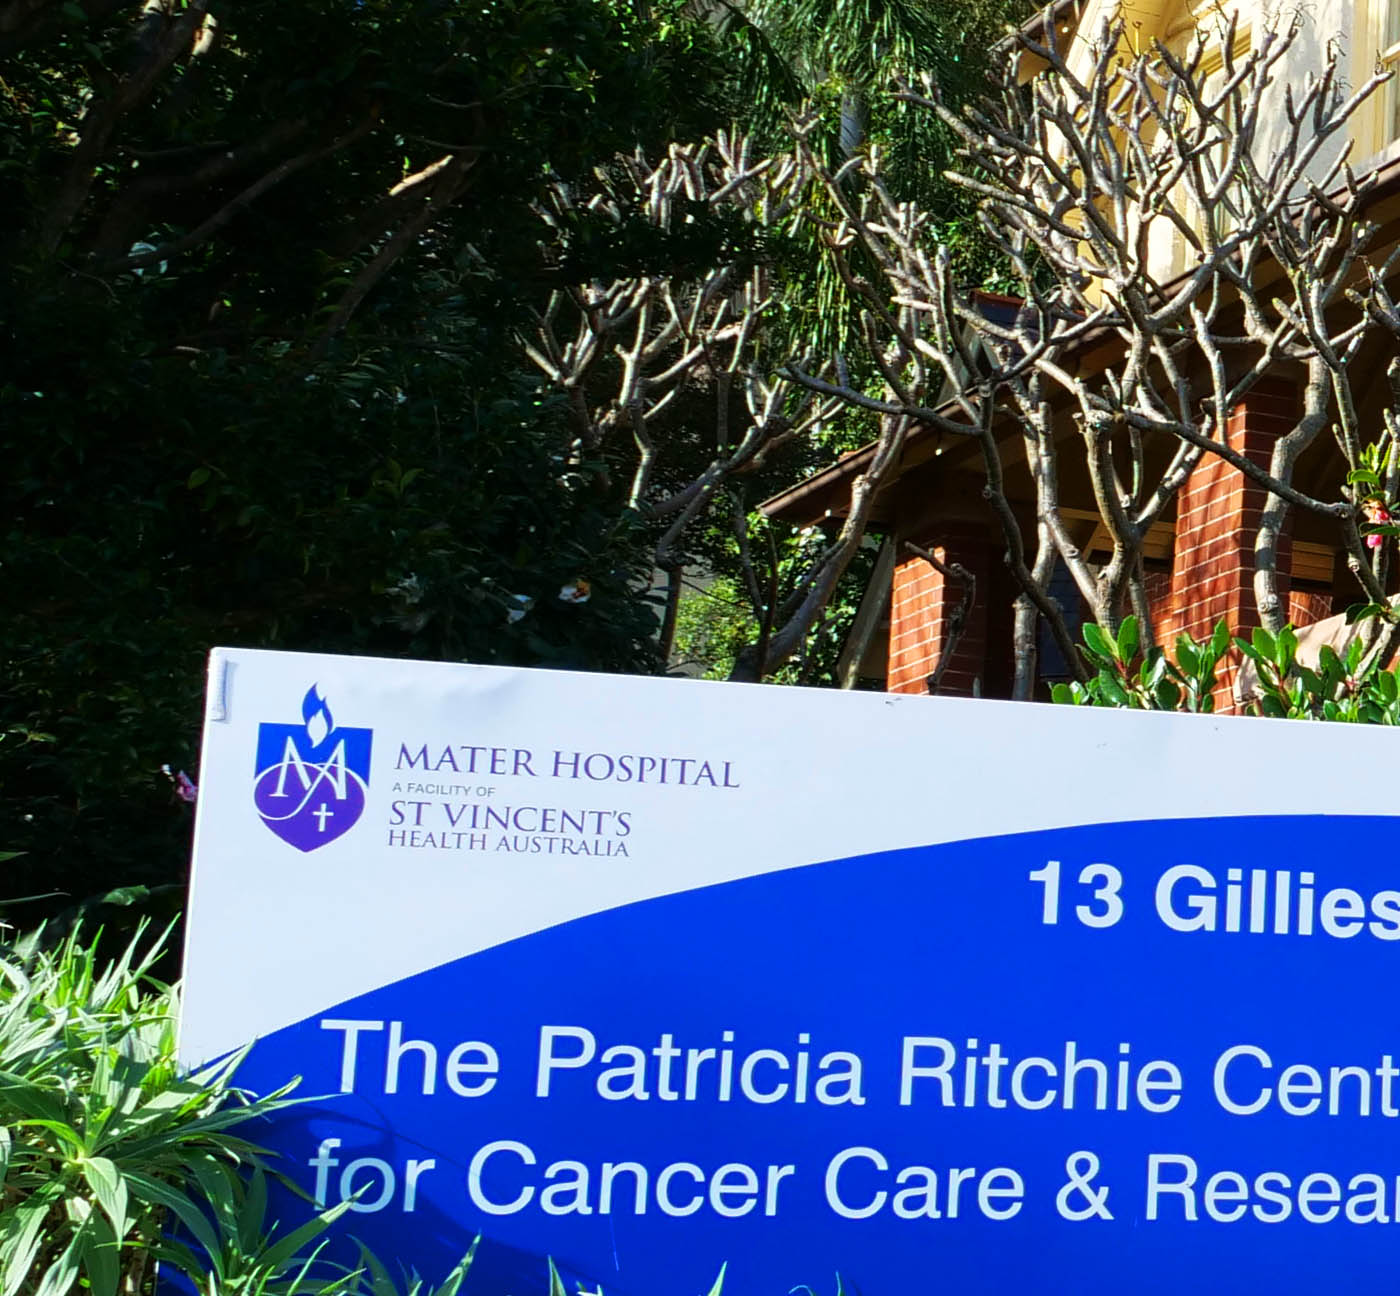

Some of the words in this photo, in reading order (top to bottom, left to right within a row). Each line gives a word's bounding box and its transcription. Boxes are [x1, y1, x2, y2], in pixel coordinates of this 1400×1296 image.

[394, 741, 538, 778] MATER
[551, 750, 741, 788] HOSPITAL
[391, 781, 403, 794] A
[407, 782, 472, 798] FACILITY
[475, 785, 497, 798] OF
[389, 800, 433, 827] ST
[442, 802, 633, 837] VINCENT'S
[387, 829, 488, 852] HEALTH
[495, 834, 631, 858] AUSTRALIA
[1029, 860, 1124, 928] 13
[320, 1019, 499, 1097] The
[536, 1025, 866, 1106] Patricia
[900, 1036, 1182, 1113] Ritchie
[307, 1137, 436, 1213] for
[467, 1140, 795, 1218] Cancer
[825, 1146, 1024, 1221] Care
[1055, 1150, 1114, 1221] &
